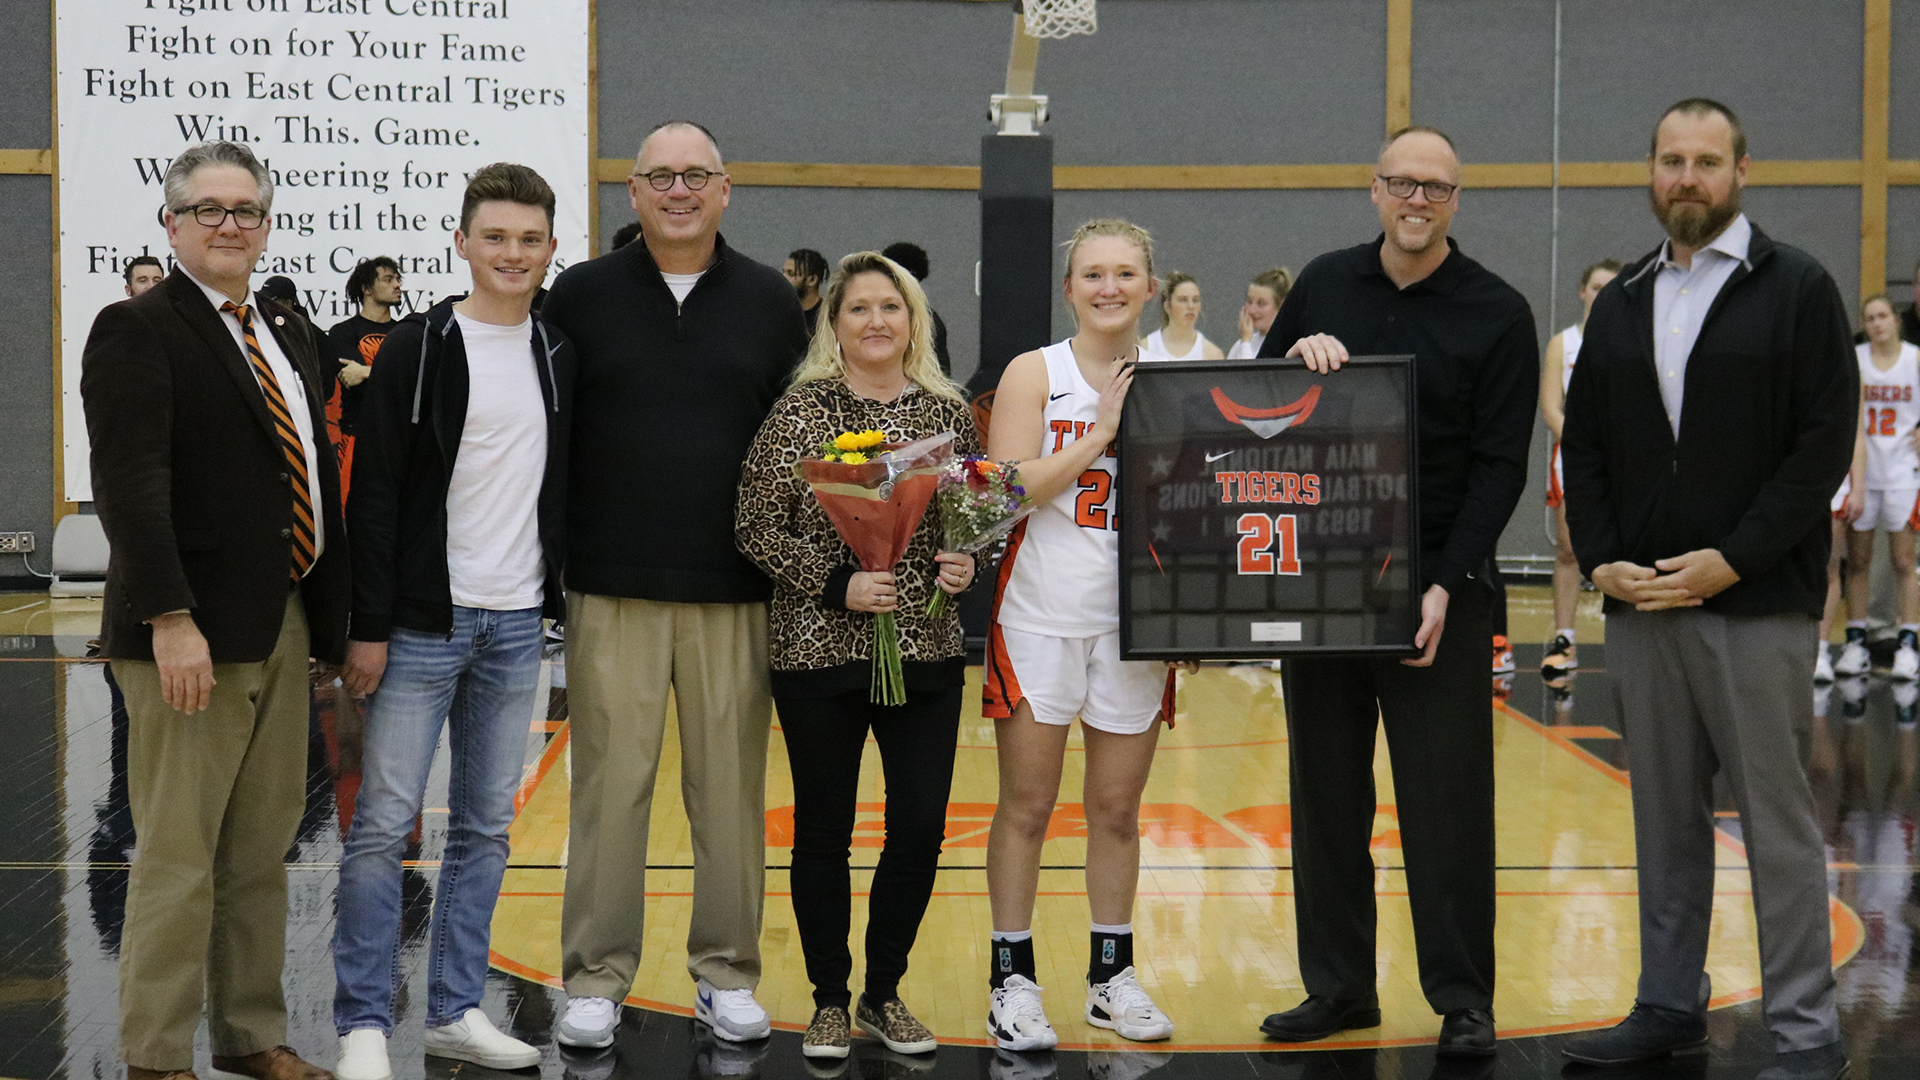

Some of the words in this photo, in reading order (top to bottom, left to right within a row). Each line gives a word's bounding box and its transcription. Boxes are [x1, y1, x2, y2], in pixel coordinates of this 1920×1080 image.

[246, 0, 289, 13] on
[385, 0, 509, 19] Central
[126, 25, 217, 61] Fight
[229, 37, 273, 56] on
[286, 27, 335, 57] for
[346, 30, 427, 60] Your
[440, 33, 526, 63] Fame
[83, 67, 175, 104] Fight
[188, 80, 231, 99] on
[245, 71, 315, 101] East
[327, 73, 452, 104] Central
[464, 76, 566, 111] Tigers
[174, 113, 261, 144] Win.
[274, 115, 360, 145] This.
[374, 117, 480, 148] Game.
[263, 157, 390, 194] heering
[402, 160, 449, 190] for
[328, 202, 363, 232] til
[376, 202, 428, 232] the
[328, 245, 454, 275] Ctral
[1867, 407, 1897, 437] 12
[1215, 470, 1321, 506] TIGERS
[1236, 512, 1302, 576] 21
